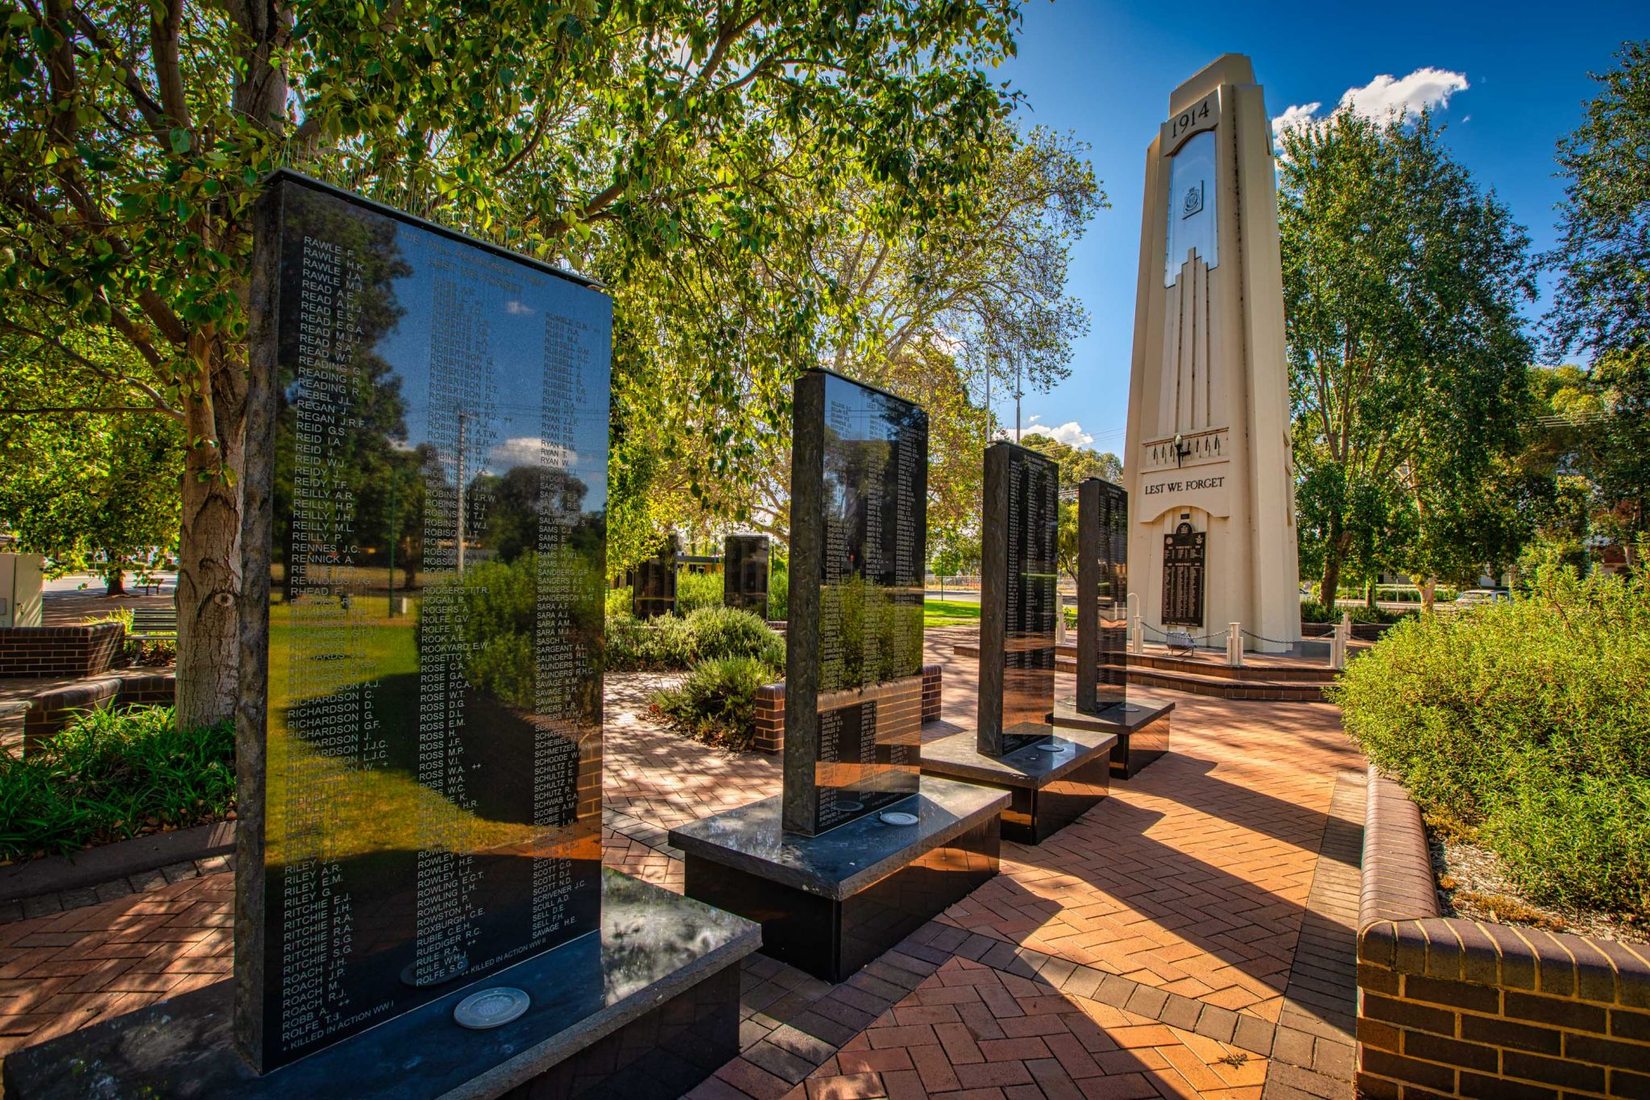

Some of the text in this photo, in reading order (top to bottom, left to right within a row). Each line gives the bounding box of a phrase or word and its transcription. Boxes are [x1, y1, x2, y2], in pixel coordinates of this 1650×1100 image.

[1172, 101, 1209, 138] 1914
[304, 235, 341, 254] RAWLE
[303, 246, 341, 265] RAWLE
[303, 257, 341, 275] RAWLE
[303, 268, 340, 286] RAWLE
[302, 279, 332, 294] READ
[302, 290, 331, 305] READ
[301, 301, 331, 316] READ
[301, 312, 330, 326] READ
[300, 323, 330, 337] READ
[300, 334, 329, 348] READ
[299, 345, 329, 358] READ
[299, 356, 347, 373] READING
[298, 367, 347, 383] READING
[298, 378, 346, 394] READING
[297, 389, 332, 402] REBEL
[297, 400, 335, 413] REGAN
[296, 411, 335, 424] REGAN
[296, 422, 322, 433] REID
[296, 433, 322, 443] REID
[295, 444, 321, 454] REID
[295, 455, 321, 465] REID
[295, 466, 327, 477] REIDY
[294, 477, 327, 487] REIDY
[1145, 477, 1224, 495] LEST WE FORGET
[294, 488, 330, 499] REILLY
[293, 499, 330, 509] REILLY
[293, 510, 329, 520] REILLY
[293, 522, 329, 531] REILLY
[293, 533, 328, 542] REILLY
[292, 544, 336, 553] RENNES
[292, 555, 340, 563] RENNICK
[422, 616, 450, 624] ROLFE
[422, 625, 450, 633] ROLFE
[421, 653, 462, 663] ROSETTO
[421, 664, 445, 673] ROSE
[421, 674, 445, 683] ROSE
[421, 683, 445, 692] ROSE
[420, 693, 445, 702] ROSE
[288, 703, 358, 719] RICHARDSON
[420, 702, 445, 712] ROSS
[288, 713, 358, 730] RICHARDSON
[420, 712, 444, 722] ROSS
[287, 724, 358, 741] RICHARDSON
[420, 721, 444, 732] ROSS
[420, 731, 444, 741] ROSS
[420, 741, 444, 751] ROSS
[420, 750, 443, 761] ROSS
[419, 760, 443, 771] ROSS
[420, 769, 443, 781] ROSS
[418, 861, 454, 879] ROWLEY
[534, 865, 556, 879] SCOTT
[285, 870, 316, 886] RILEY
[417, 870, 455, 889] ROWLEY
[533, 874, 556, 887] SCOTT
[284, 881, 316, 897] RILEY
[417, 879, 458, 898] ROWLING
[533, 882, 555, 896] SCOTT
[284, 892, 316, 909] RILEY
[417, 888, 458, 908] ROWLING
[284, 899, 328, 920] RITCHIE
[417, 898, 457, 918] ROWLING
[284, 910, 328, 931] RITCHIE
[417, 906, 461, 928] ROWSTON
[533, 910, 549, 922] SELL
[284, 921, 327, 942] RITCHIE
[417, 914, 465, 938] ROXBURGH
[533, 918, 549, 930] SELL
[284, 931, 327, 953] RITCHIE
[417, 931, 443, 947] RUBIE
[417, 934, 461, 957] RUEDIGER
[283, 942, 327, 964] RITCHIE
[417, 951, 440, 967] RULE
[283, 953, 327, 976] RITCHIE
[416, 961, 439, 977] RULE
[283, 965, 323, 987] ROACH
[416, 968, 445, 987] ROLFE
[283, 976, 323, 998] ROACH
[283, 986, 323, 1009] ROACH
[283, 997, 322, 1020] ROACH
[283, 1011, 313, 1031] ROBB
[282, 1020, 319, 1043] ROLFE
[291, 1029, 323, 1050] KILLED
[327, 1024, 335, 1035] IN
[338, 1009, 371, 1030] ACTION
